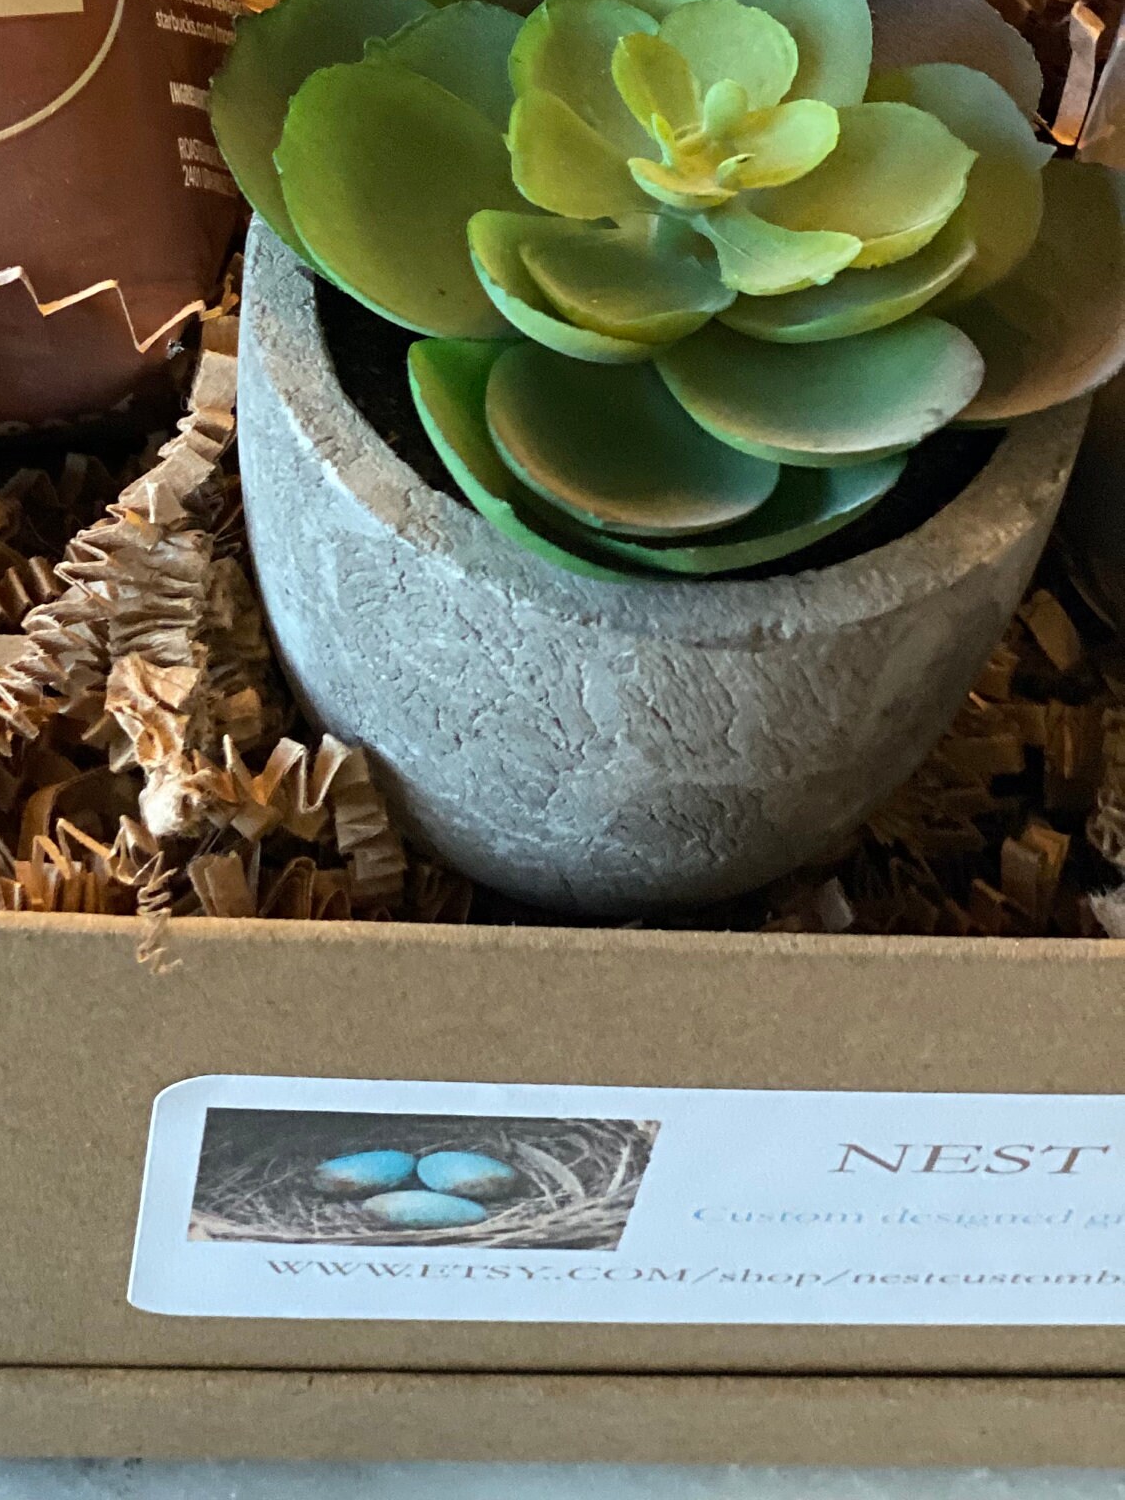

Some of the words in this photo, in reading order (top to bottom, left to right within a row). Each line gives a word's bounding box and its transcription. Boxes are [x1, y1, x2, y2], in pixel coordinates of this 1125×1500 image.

[827, 1143, 1111, 1175] NEST
[692, 1207, 865, 1225] Custom
[880, 1208, 1075, 1229] designed
